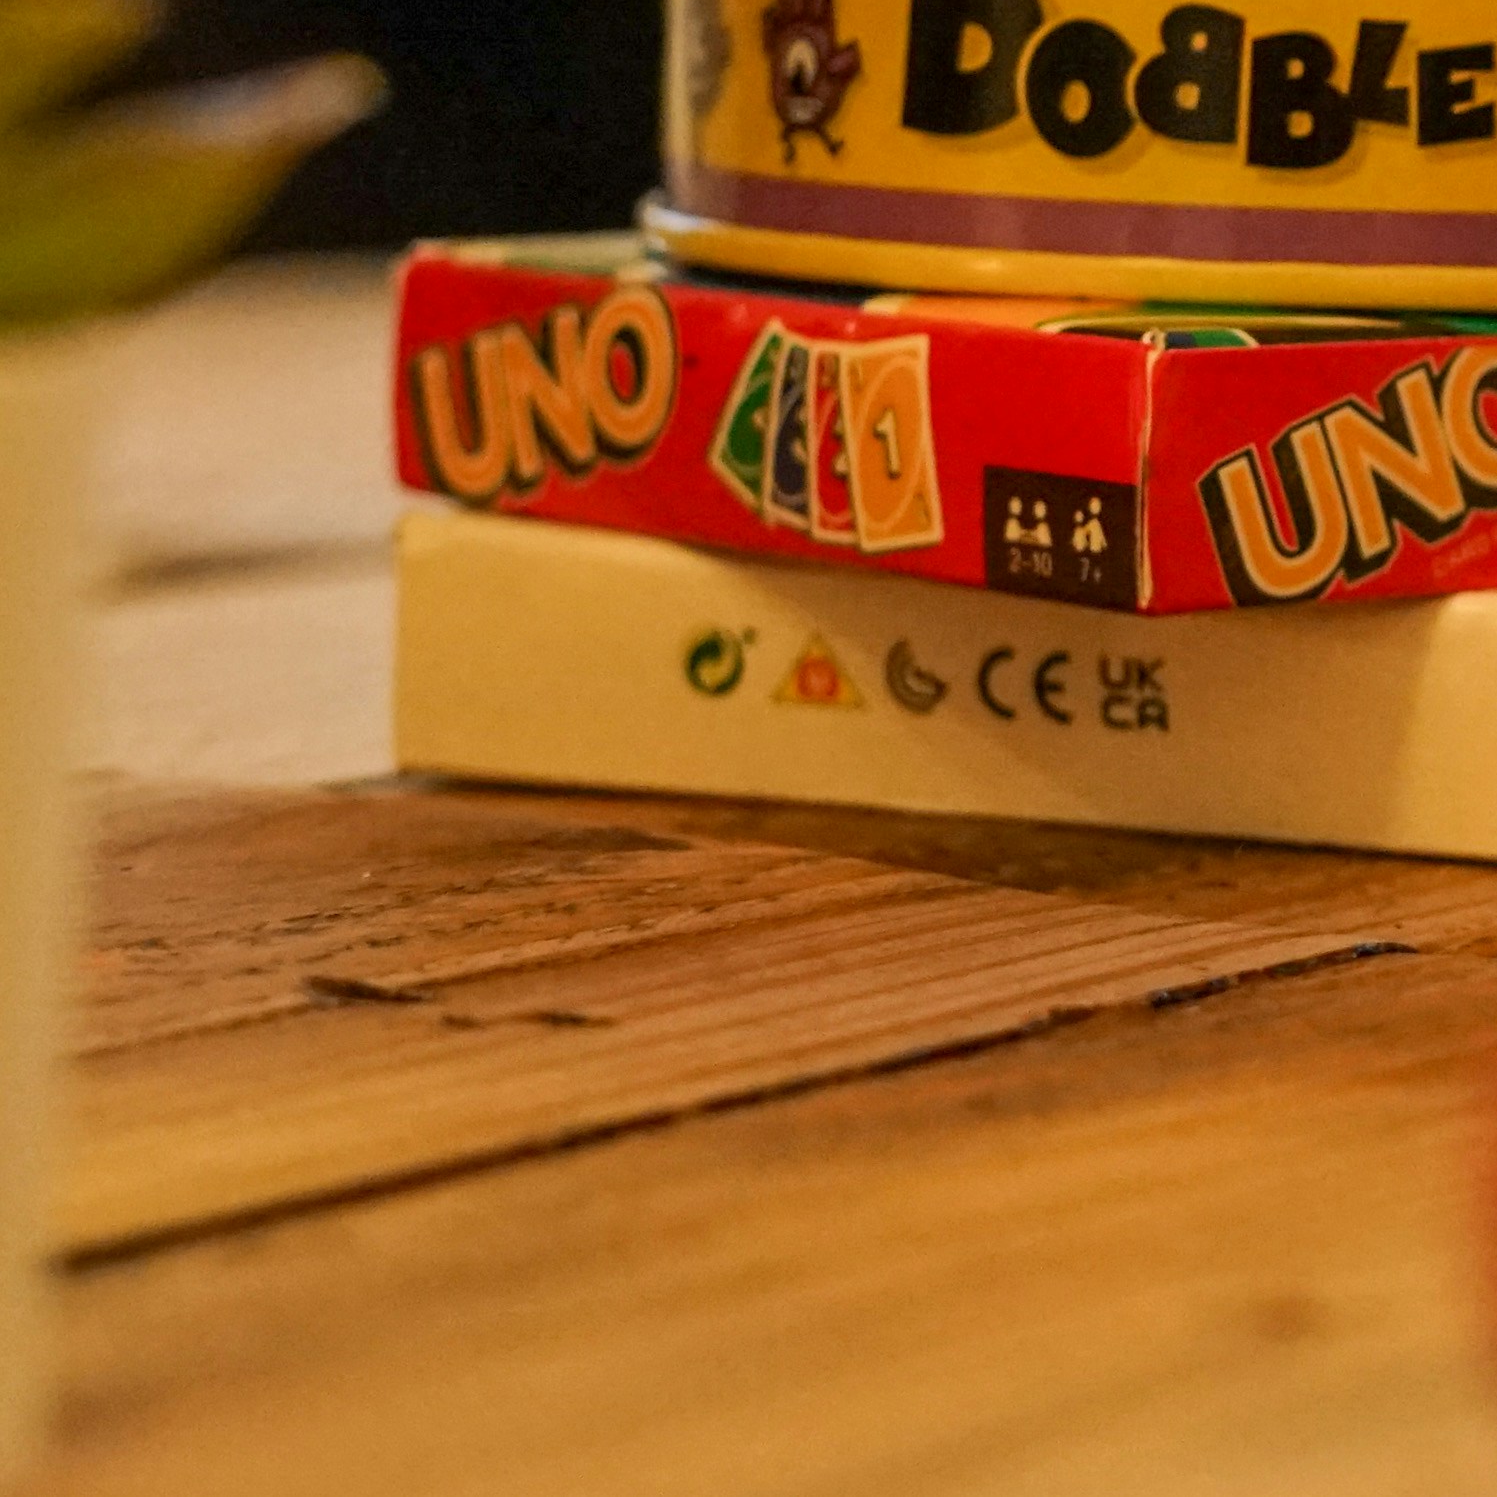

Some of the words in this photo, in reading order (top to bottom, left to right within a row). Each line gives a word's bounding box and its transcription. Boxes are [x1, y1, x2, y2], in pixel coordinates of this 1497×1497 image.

[410, 281, 680, 507] UNO
[872, 405, 902, 480] 1
[1008, 546, 1053, 577] 2-10
[1099, 653, 1167, 690] UK
